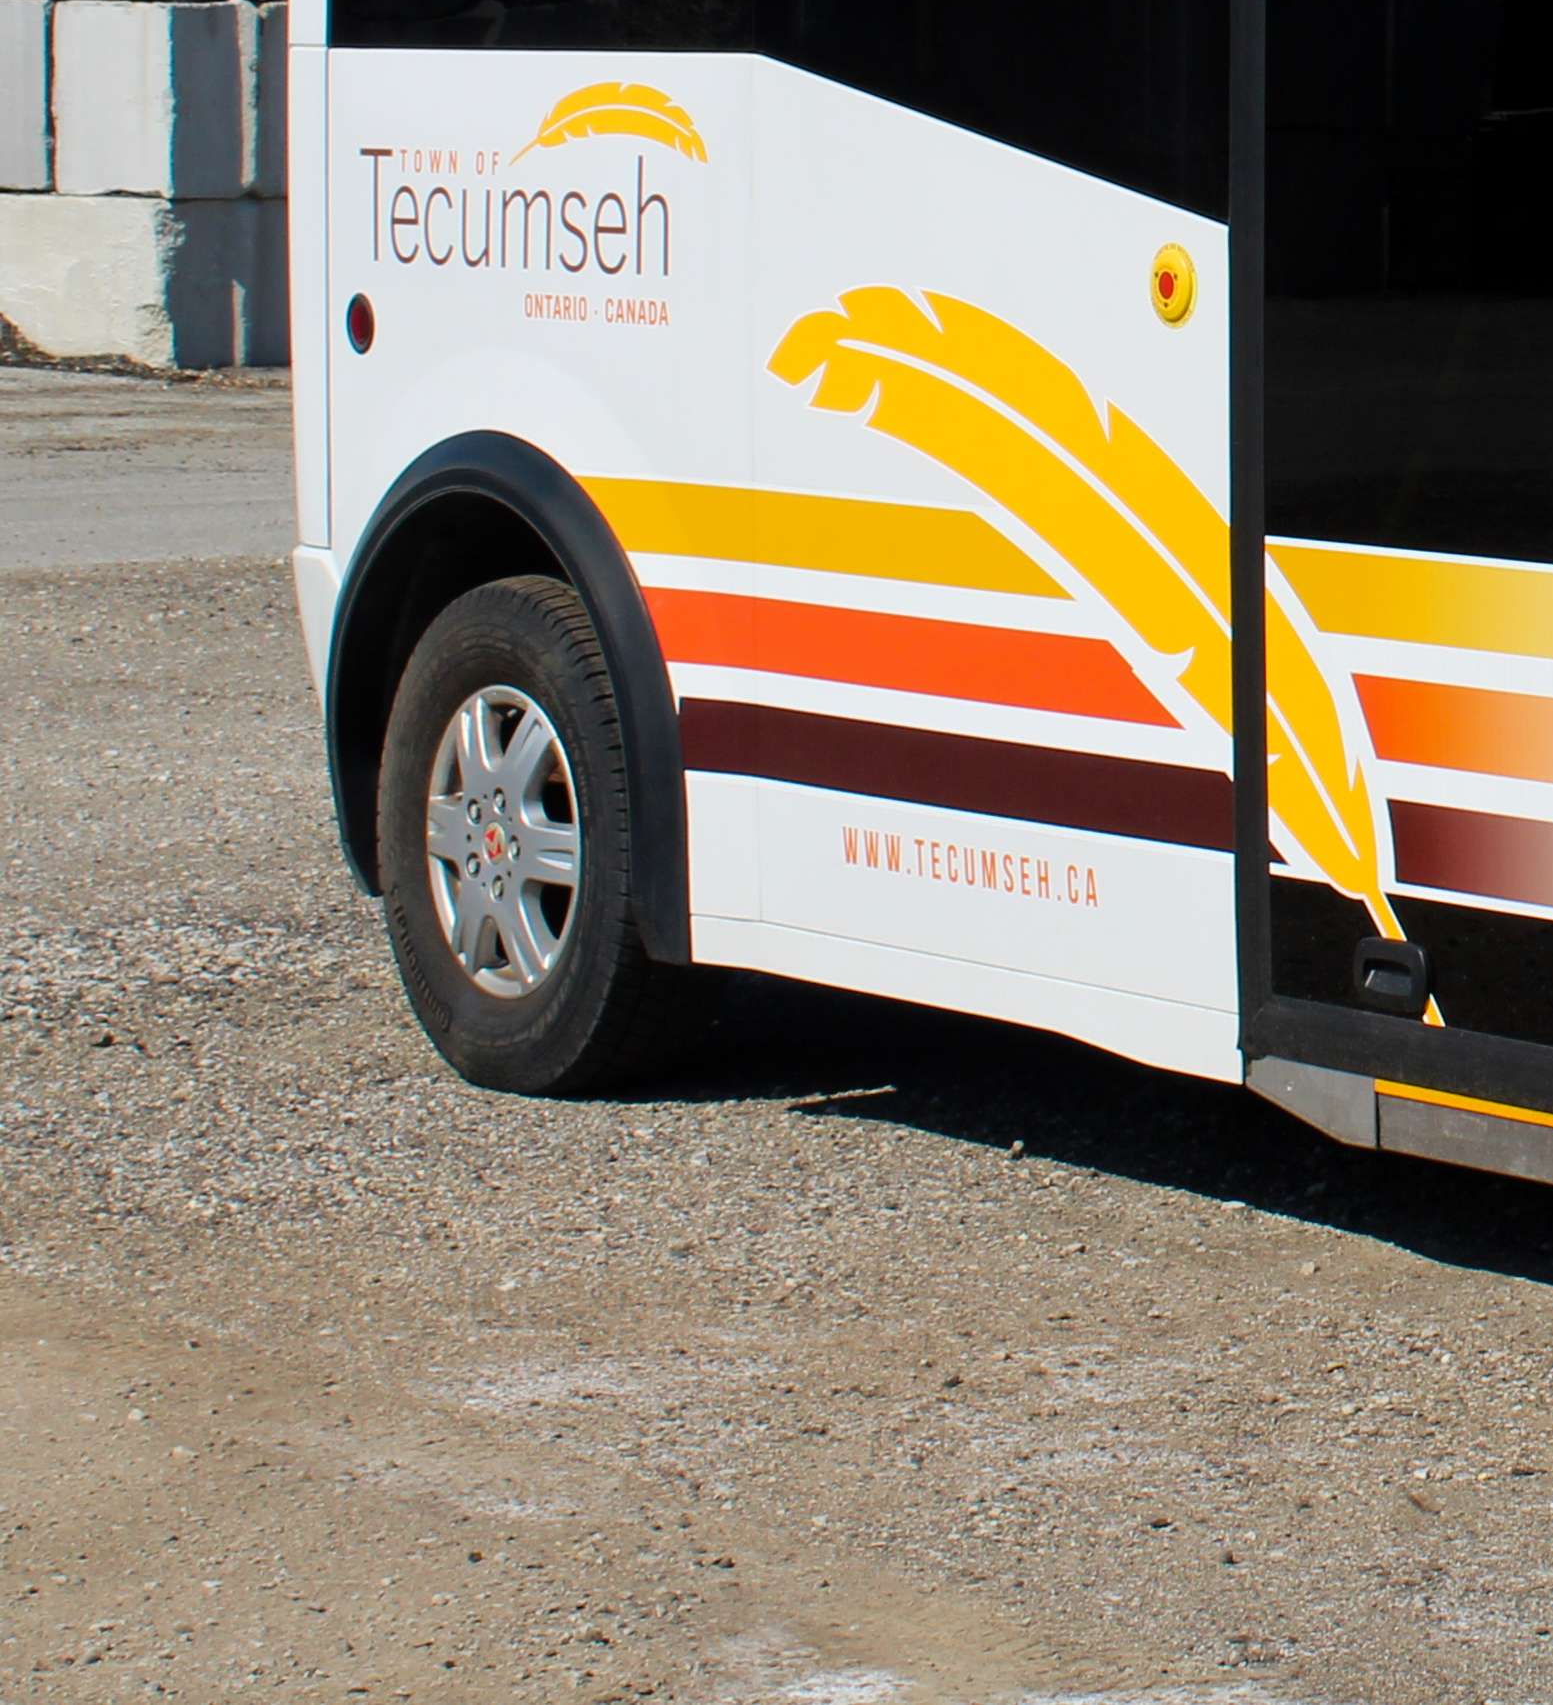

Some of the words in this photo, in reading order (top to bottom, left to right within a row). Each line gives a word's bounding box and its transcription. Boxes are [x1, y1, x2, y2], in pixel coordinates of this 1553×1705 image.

[399, 149, 458, 175] TOWN
[476, 151, 500, 176] OF
[359, 148, 670, 277] Tecumseh
[524, 293, 588, 322] ONTARIO
[604, 295, 670, 326] CANADA
[842, 826, 1098, 908] WWW.TECUMSEH.CA
